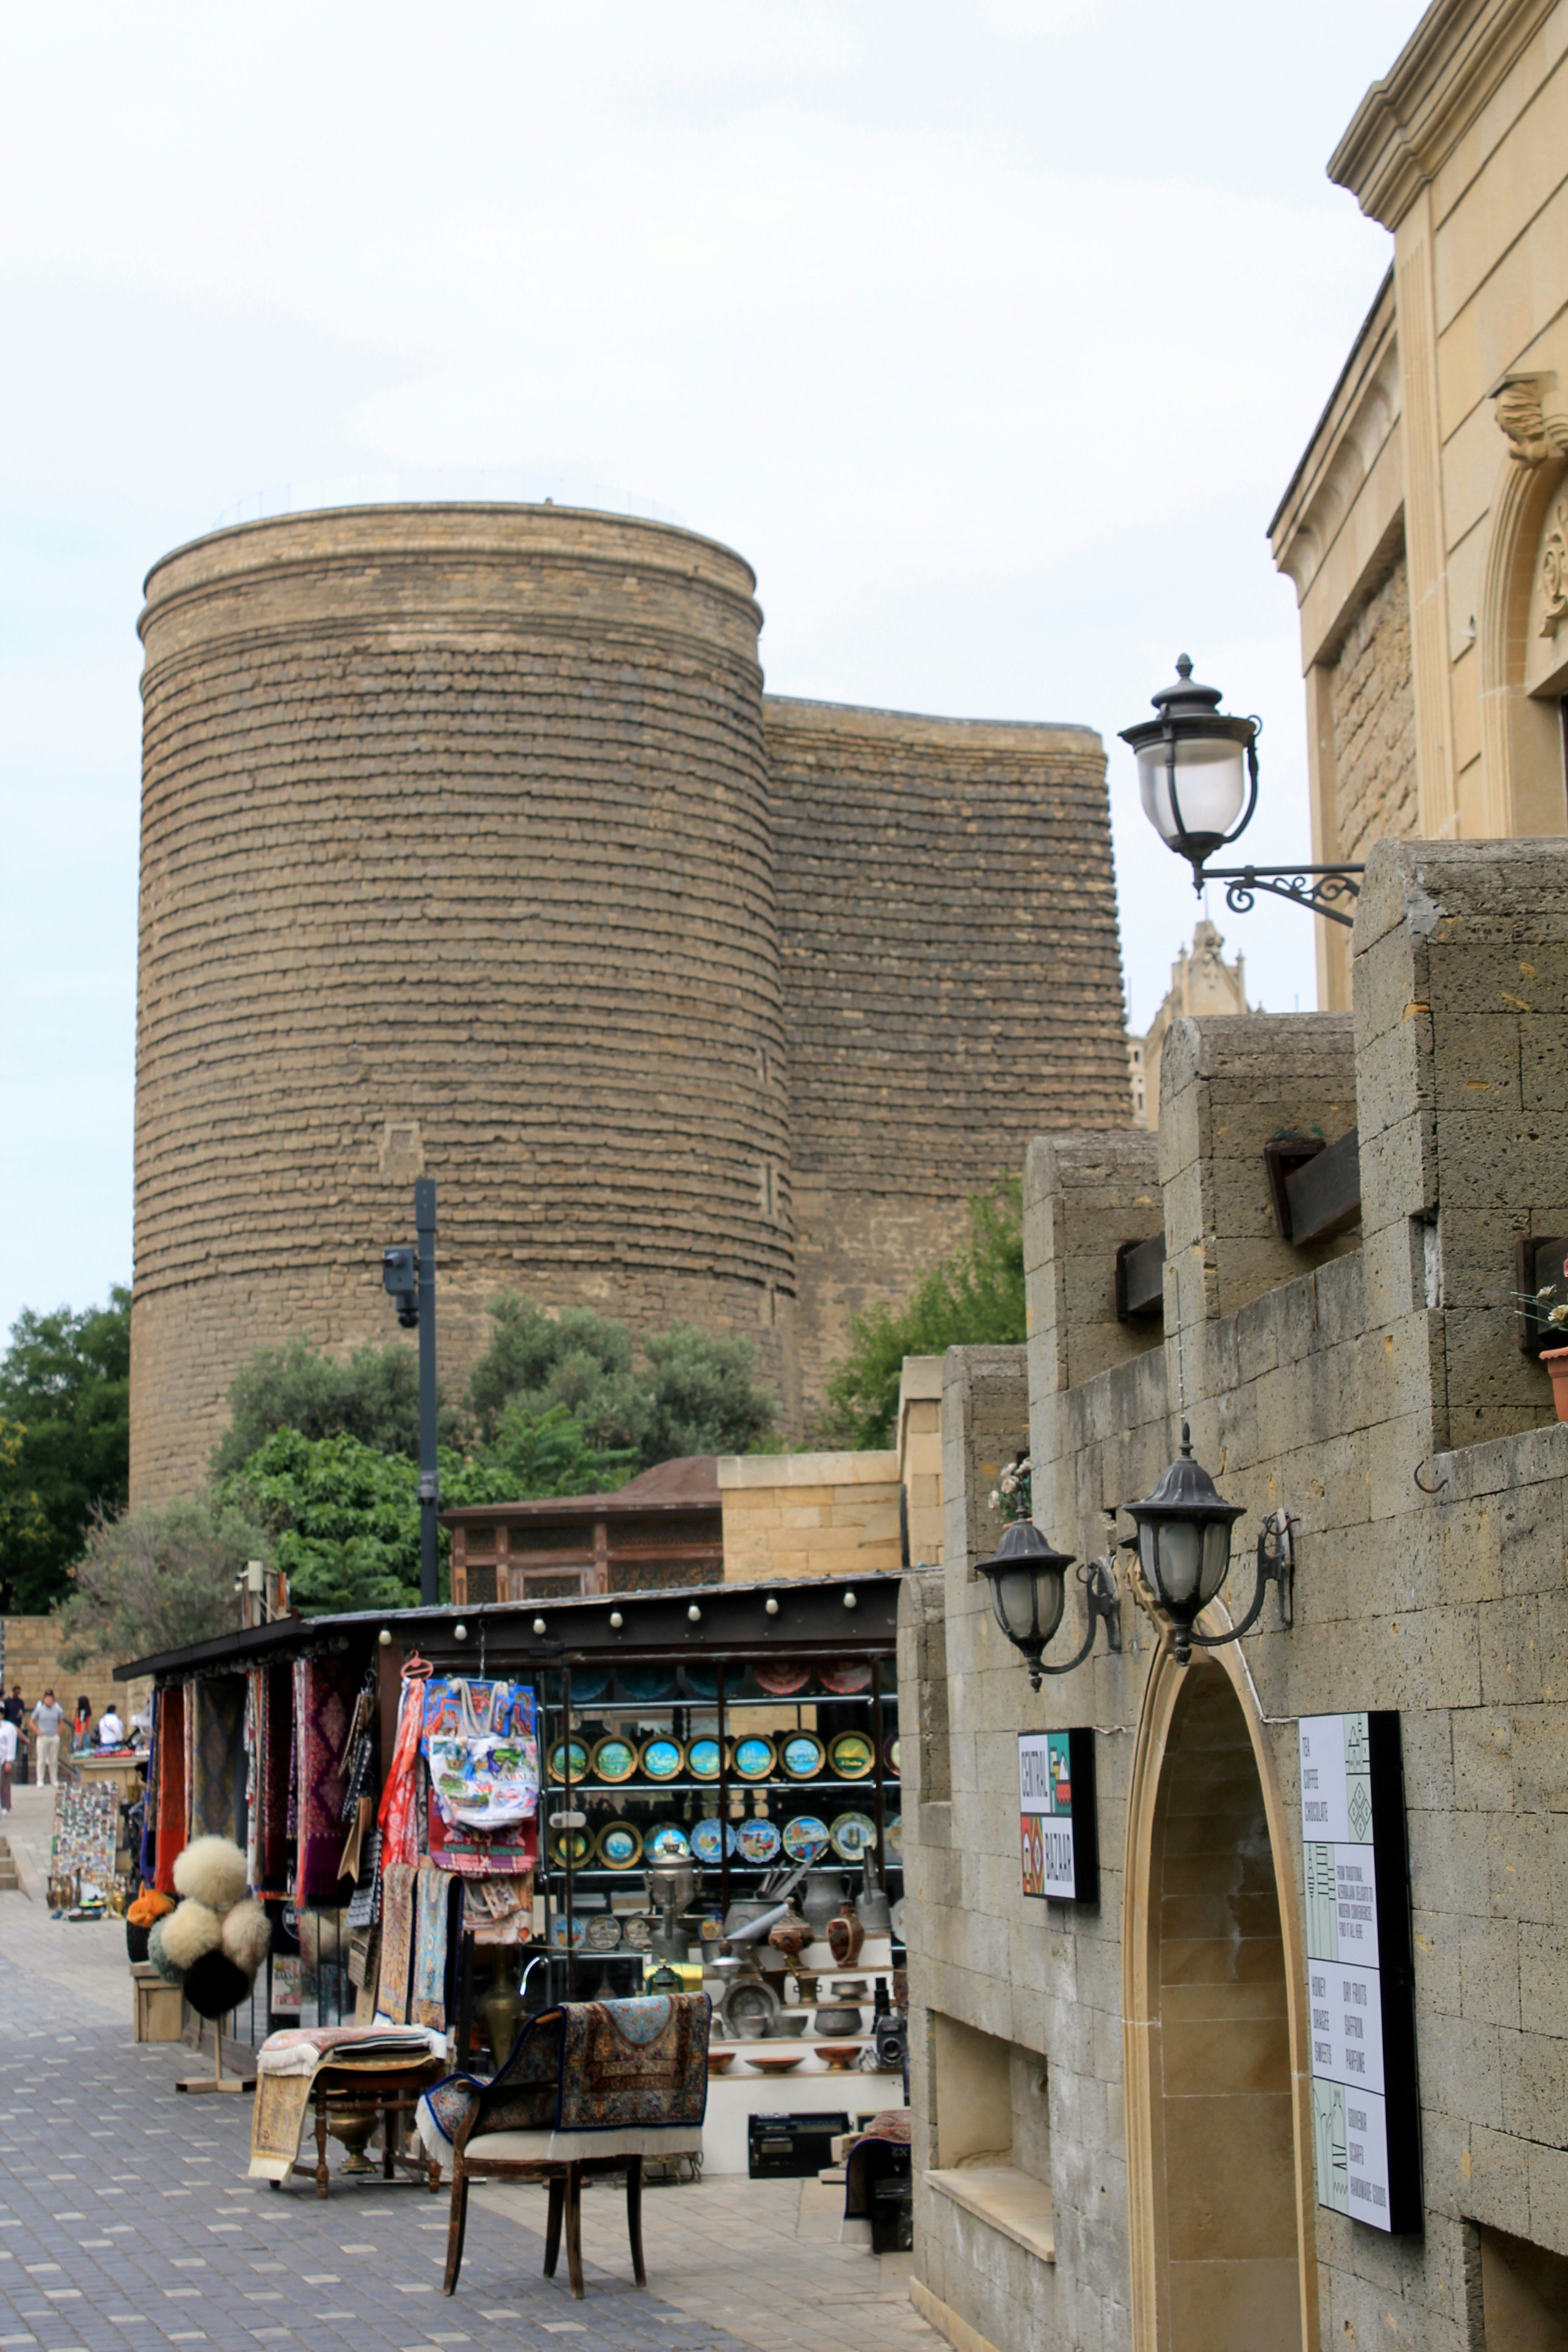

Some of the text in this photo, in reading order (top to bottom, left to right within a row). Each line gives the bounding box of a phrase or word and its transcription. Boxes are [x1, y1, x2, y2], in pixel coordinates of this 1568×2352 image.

[1303, 1769, 1318, 1789] COFFEE
[1305, 1802, 1328, 1822] CHOCOLATE
[1045, 1833, 1072, 1882] BAZAAR
[1337, 1865, 1363, 1882] FROM TRADITIONAL
[1338, 1903, 1351, 1918] MODERN
[1312, 1976, 1326, 1998] HONEY
[1343, 1981, 1367, 2006] DRY FRUITS
[1313, 2009, 1330, 2031] DRAGEE
[1344, 2014, 1363, 2039] SAFFRON
[1314, 2041, 1332, 2065] SWEETS
[1346, 2048, 1366, 2074] PARFUME
[1348, 2107, 1367, 2132] SOUVENIR
[1349, 2141, 1364, 2165] SCARFS
[1351, 2176, 1386, 2208] HANDMADE GOODS
